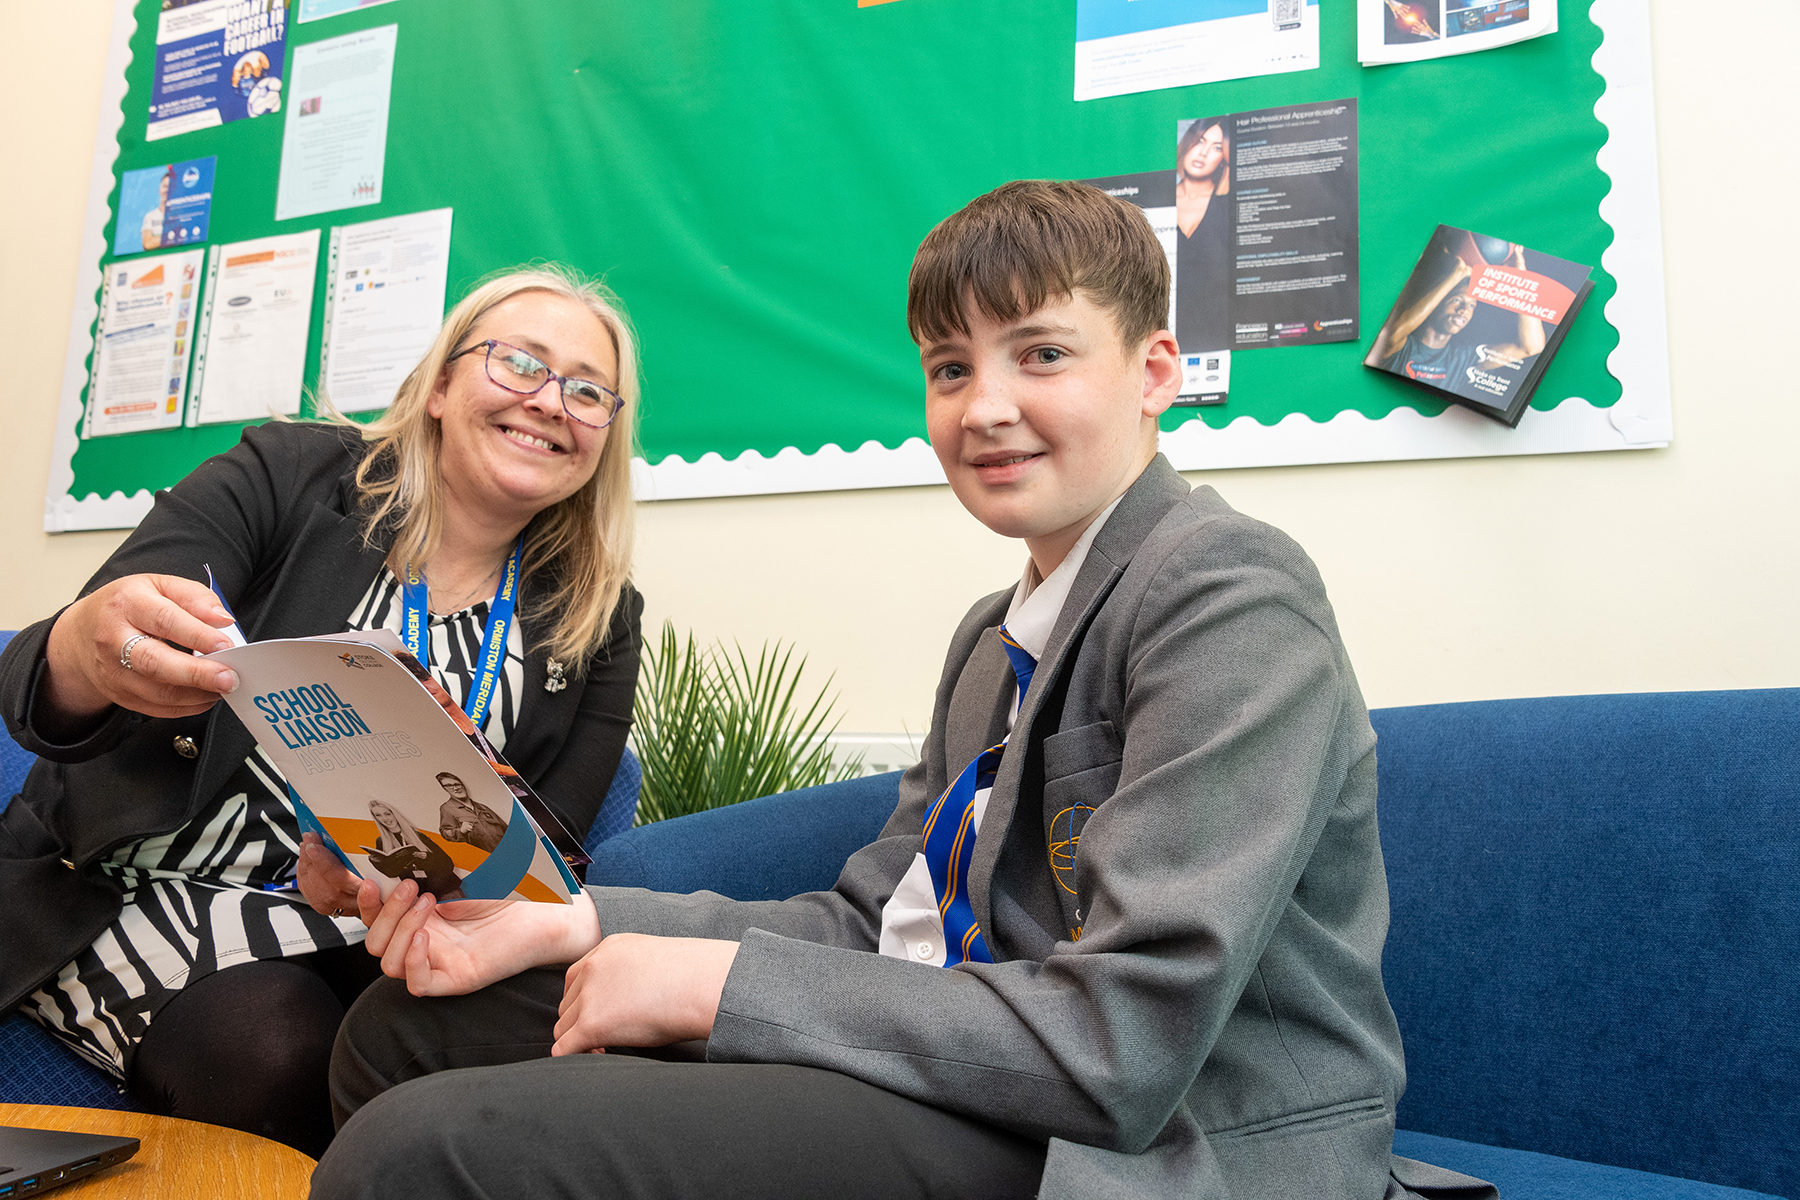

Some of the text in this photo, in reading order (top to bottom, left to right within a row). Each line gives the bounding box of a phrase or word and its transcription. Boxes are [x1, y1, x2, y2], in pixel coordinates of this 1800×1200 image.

[223, 24, 284, 56] FOOTBALL?
[1251, 112, 1291, 125] Professional
[1478, 277, 1538, 303] OF SPORTS
[1483, 267, 1539, 291] INSTITUTE
[1471, 286, 1557, 320] PERFORMANCE
[1475, 375, 1508, 392] College
[501, 559, 515, 602] ACADEMY
[407, 607, 420, 659] ACADEMY
[485, 619, 506, 672] ORMISTON
[253, 683, 353, 724] SCHOOL
[271, 708, 372, 750] LIAISON
[294, 730, 423, 776] ACTIVITIES
